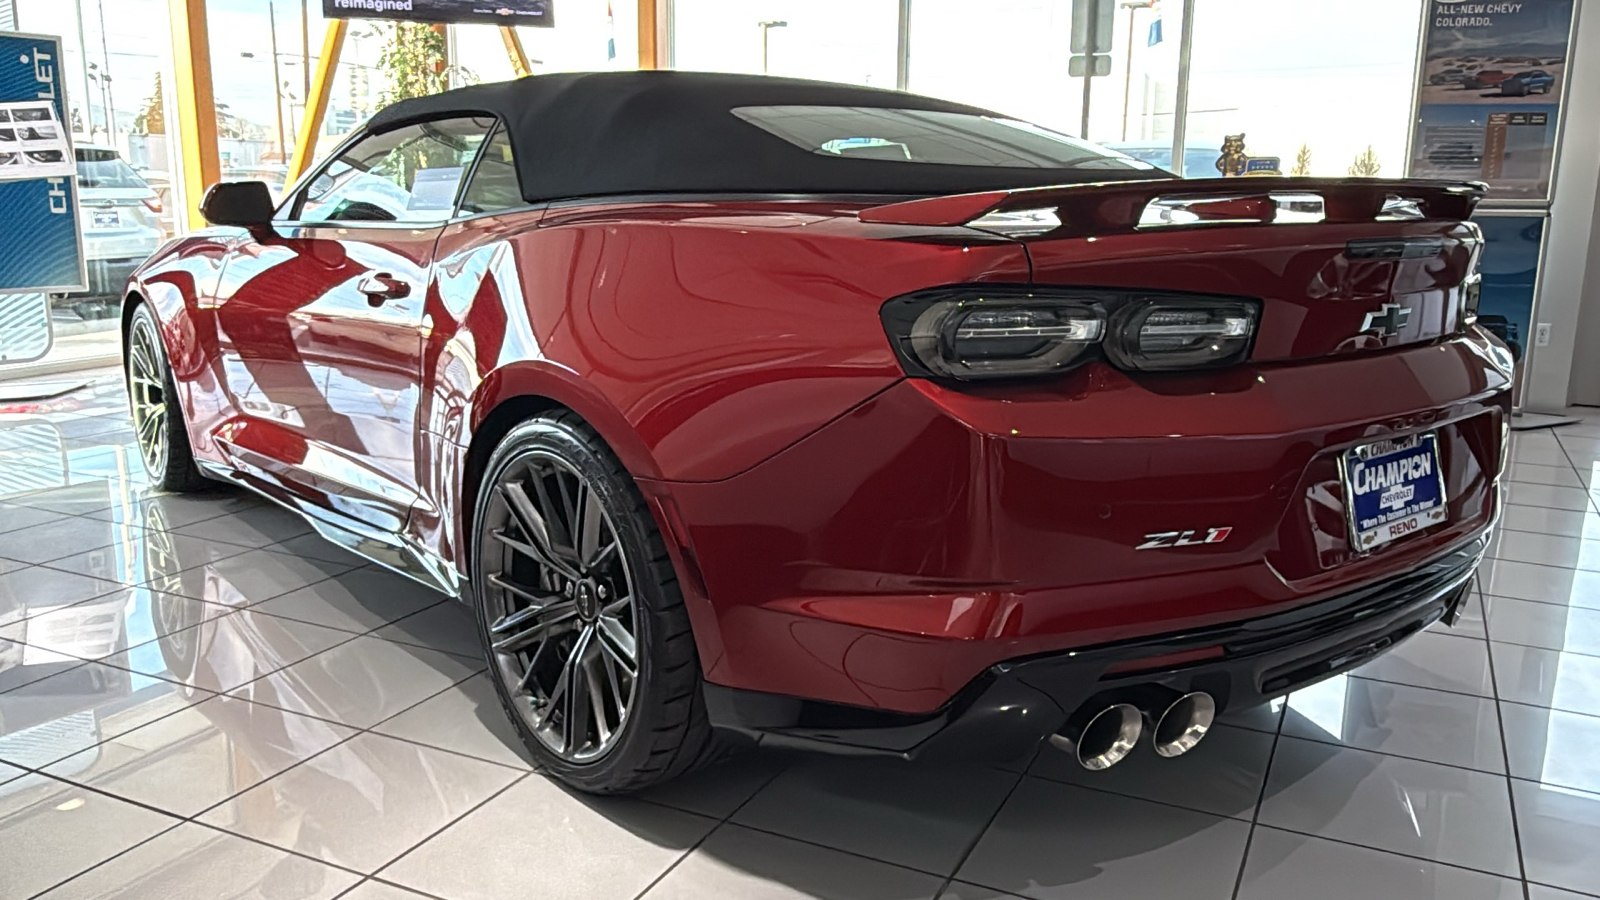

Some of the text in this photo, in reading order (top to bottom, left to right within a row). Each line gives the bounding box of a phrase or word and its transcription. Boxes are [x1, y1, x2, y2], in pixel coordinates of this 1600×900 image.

[334, 0, 413, 12] reimagined
[1437, 4, 1522, 14] ALL-NEW CHEVY
[1435, 17, 1493, 27] COLORADO.
[1371, 434, 1413, 456] CHAMION
[1353, 452, 1431, 495] CHAMPION
[1381, 488, 1412, 504] CHEVROLET
[1388, 517, 1418, 537] RENO
[1135, 526, 1233, 550] ZL1
